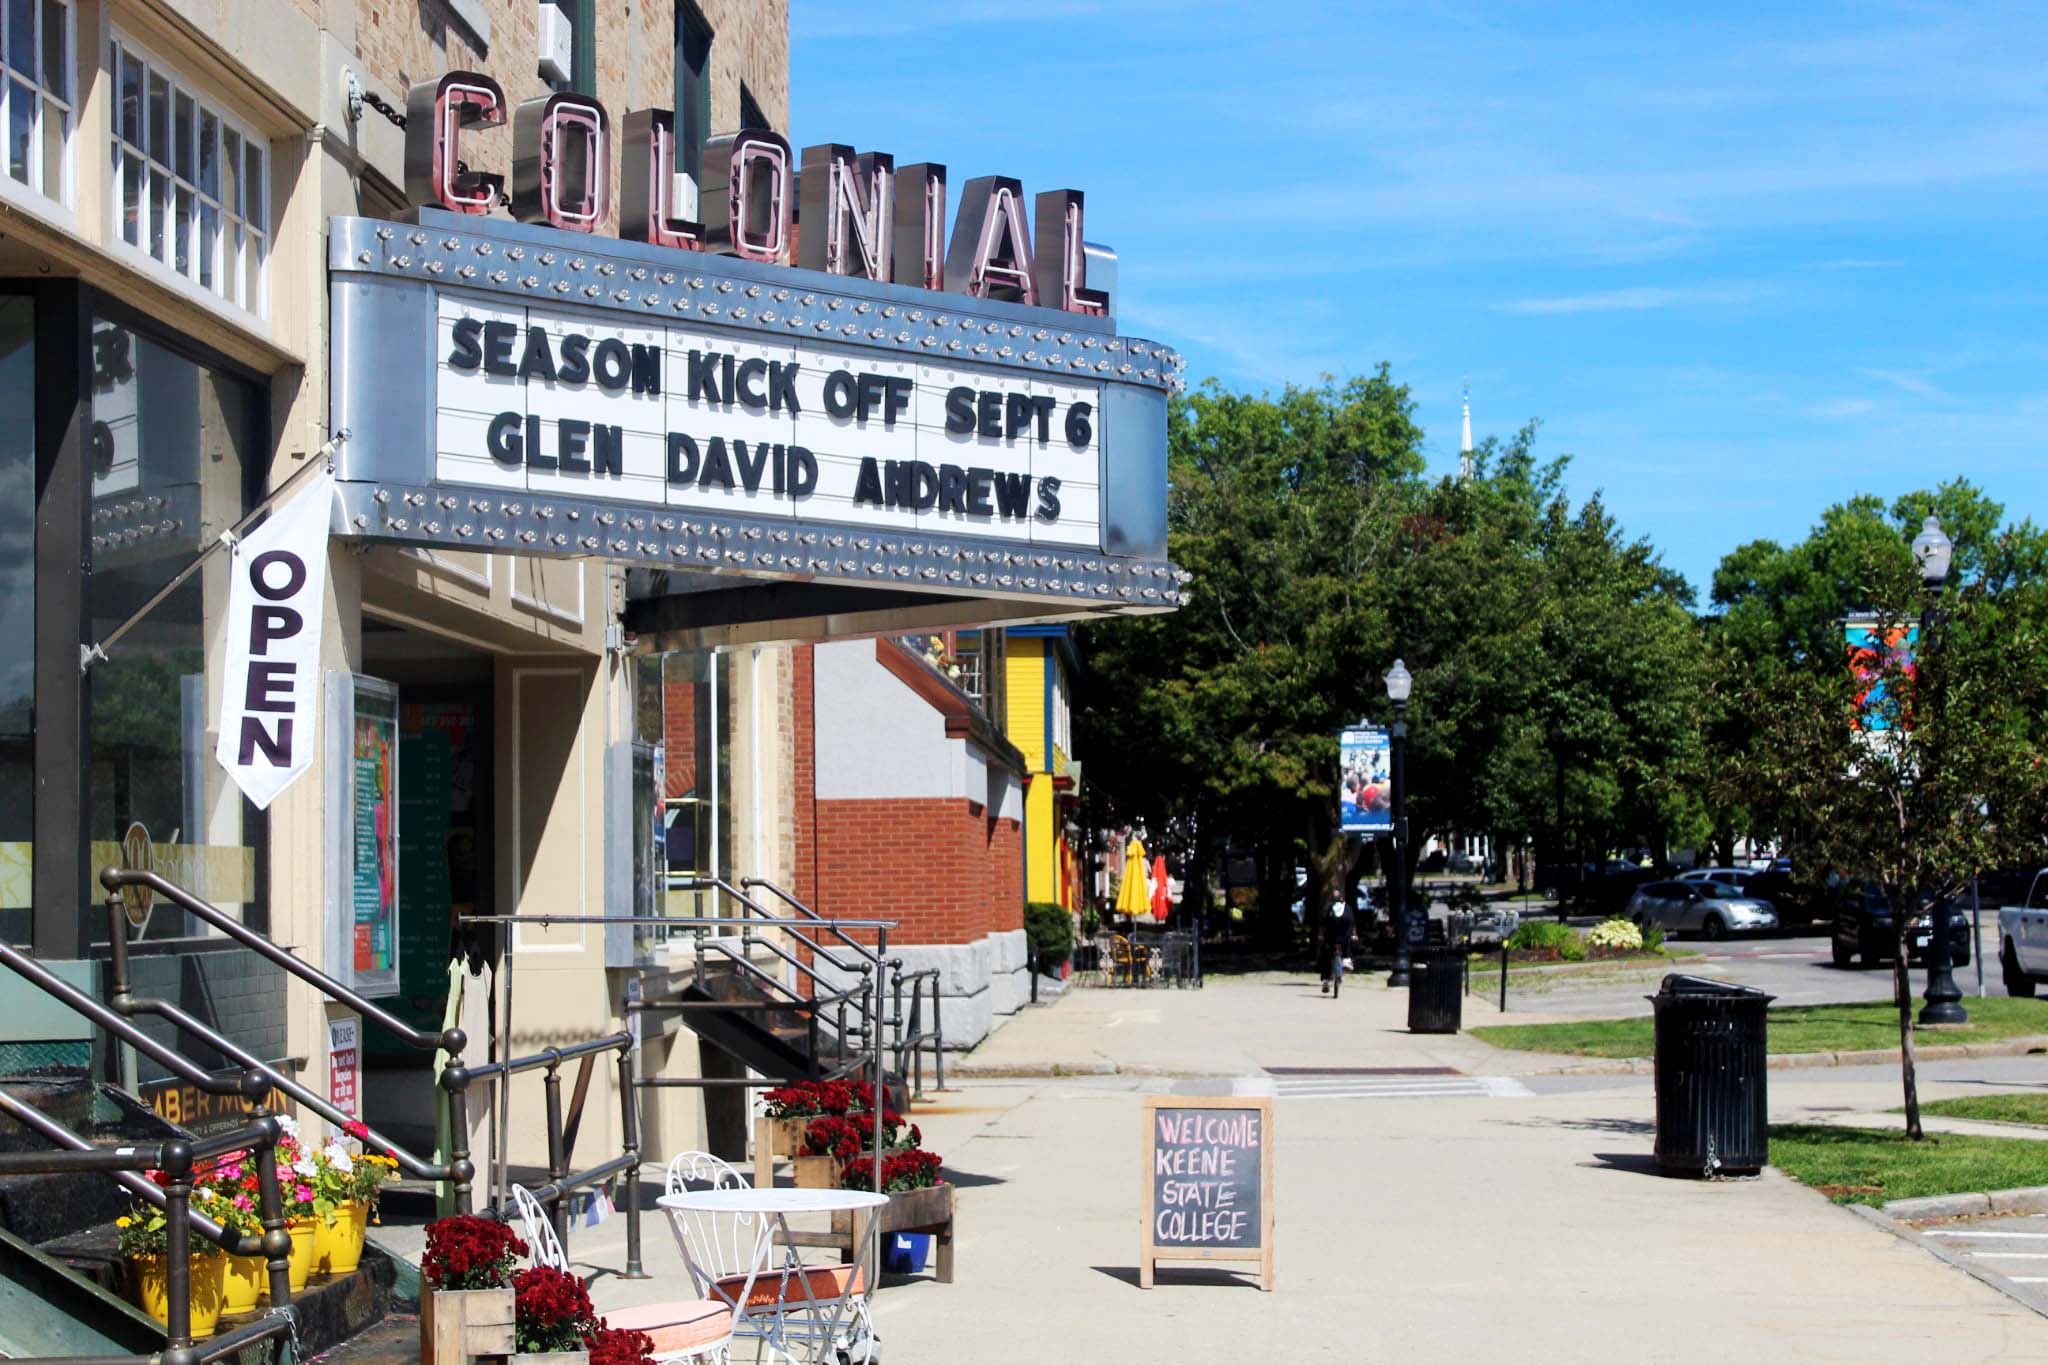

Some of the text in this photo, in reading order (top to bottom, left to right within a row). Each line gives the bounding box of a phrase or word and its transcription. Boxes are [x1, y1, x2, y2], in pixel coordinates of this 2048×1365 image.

[408, 70, 1110, 315] COLONIAL
[448, 318, 1092, 447] SEASON KICK OFF SEPT 6
[486, 411, 1062, 521] GLEN DAVID ANDREWS
[238, 550, 307, 768] OPEN
[1156, 1147, 1236, 1176] KEENE
[1158, 1114, 1259, 1148] WELCOME
[1156, 1209, 1248, 1241] COLLEGE
[1162, 1180, 1237, 1208] STATE
